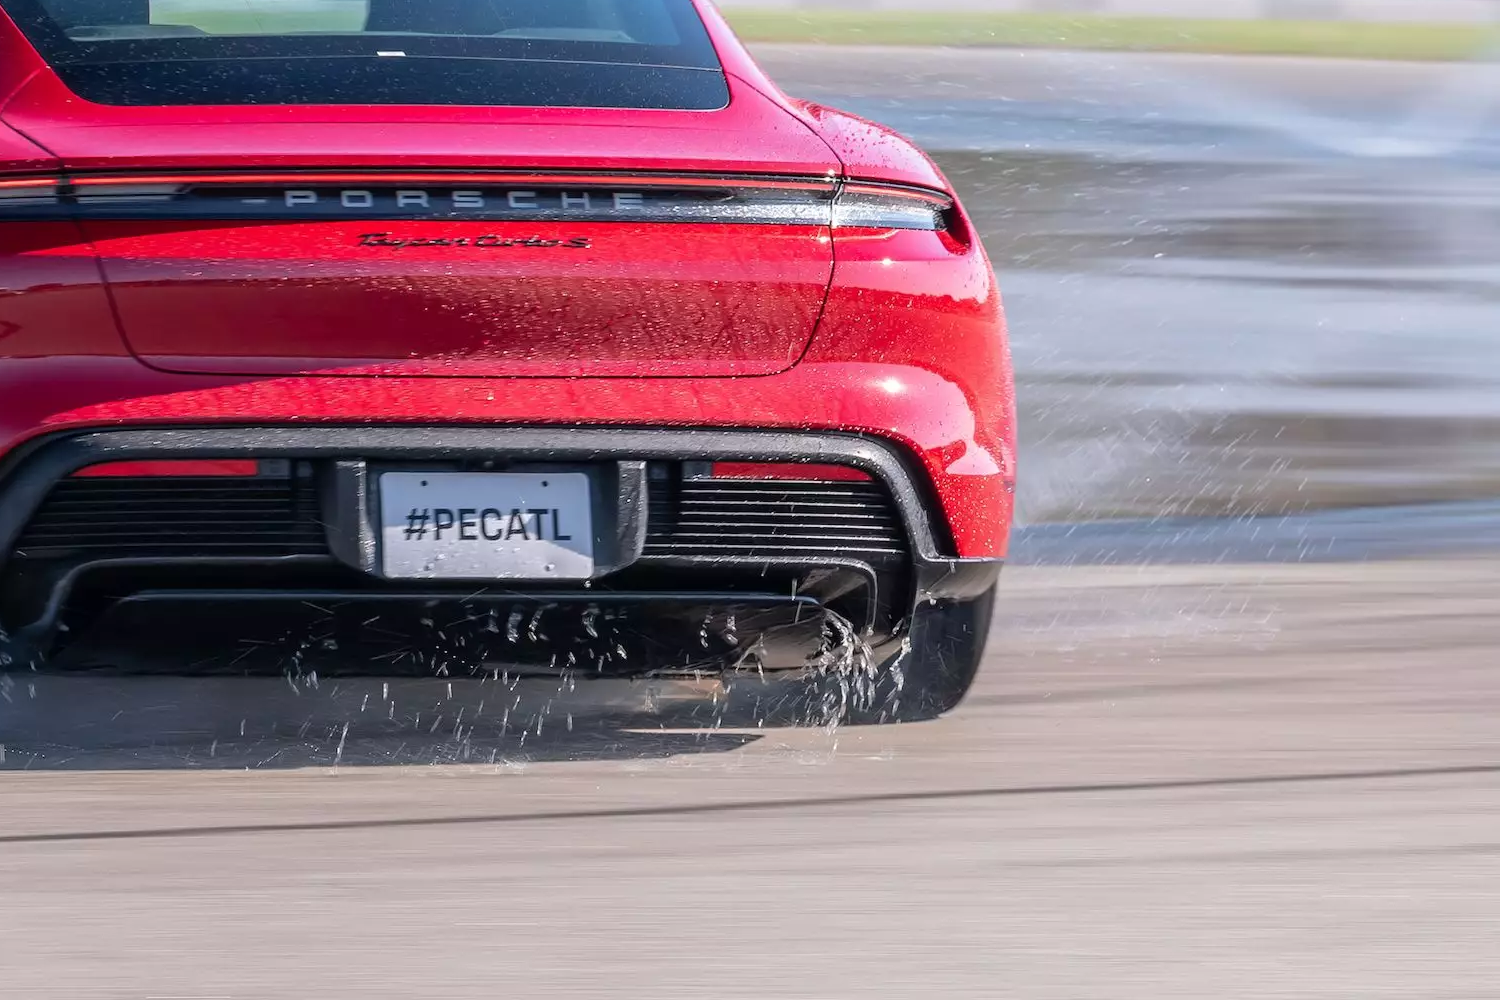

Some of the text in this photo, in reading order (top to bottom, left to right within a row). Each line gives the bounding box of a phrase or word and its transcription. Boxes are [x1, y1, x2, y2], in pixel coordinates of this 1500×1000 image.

[284, 190, 644, 210] PORSCHE
[564, 237, 592, 248] S
[403, 508, 572, 541] #PECATL
